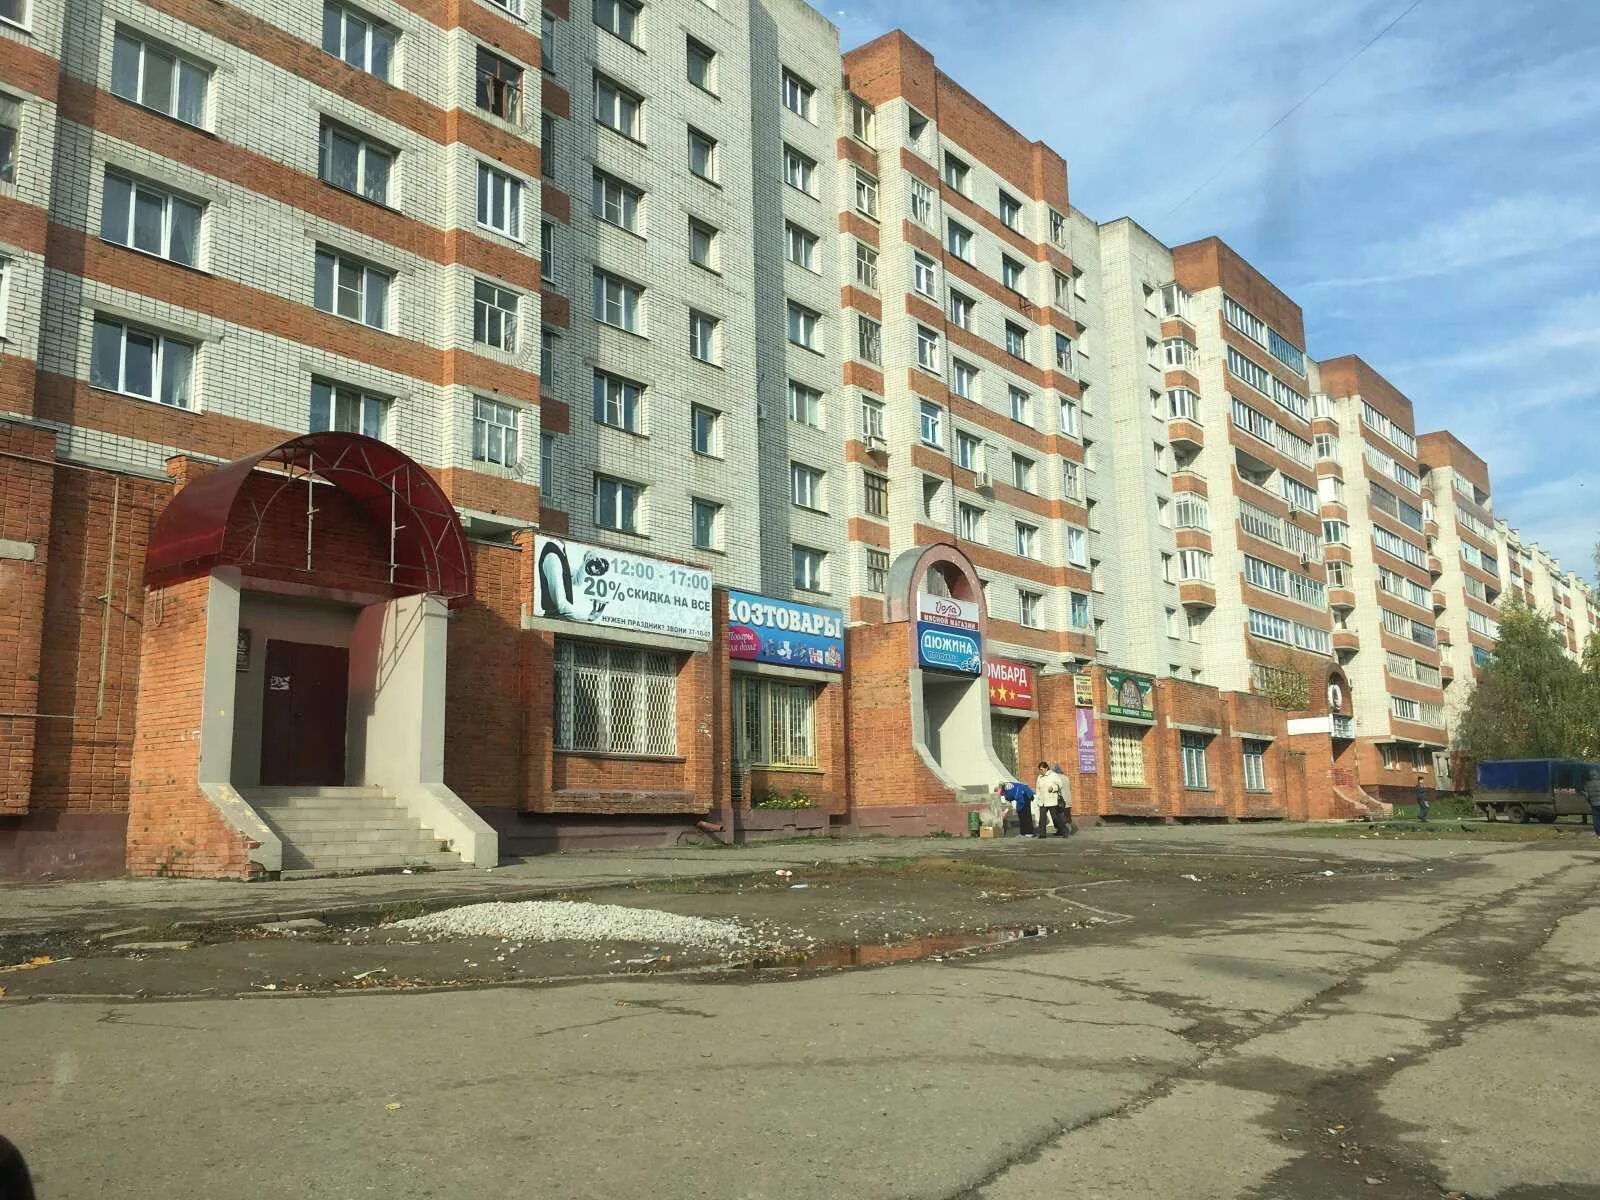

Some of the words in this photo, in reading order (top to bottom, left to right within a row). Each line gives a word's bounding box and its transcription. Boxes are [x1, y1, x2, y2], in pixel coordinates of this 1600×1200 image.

[611, 557, 655, 580] 12:00
[669, 569, 709, 591] 17:00
[583, 576, 626, 602] 20%
[626, 587, 671, 605] СКИДКА
[673, 595, 689, 608] НА
[691, 599, 711, 612] ВСЕ
[601, 615, 626, 625] НУЖЕН
[627, 618, 665, 630] ПРАЗДНИК?
[666, 624, 687, 634] ЗВОНИ
[923, 635, 973, 655] ДЮЖИНА
